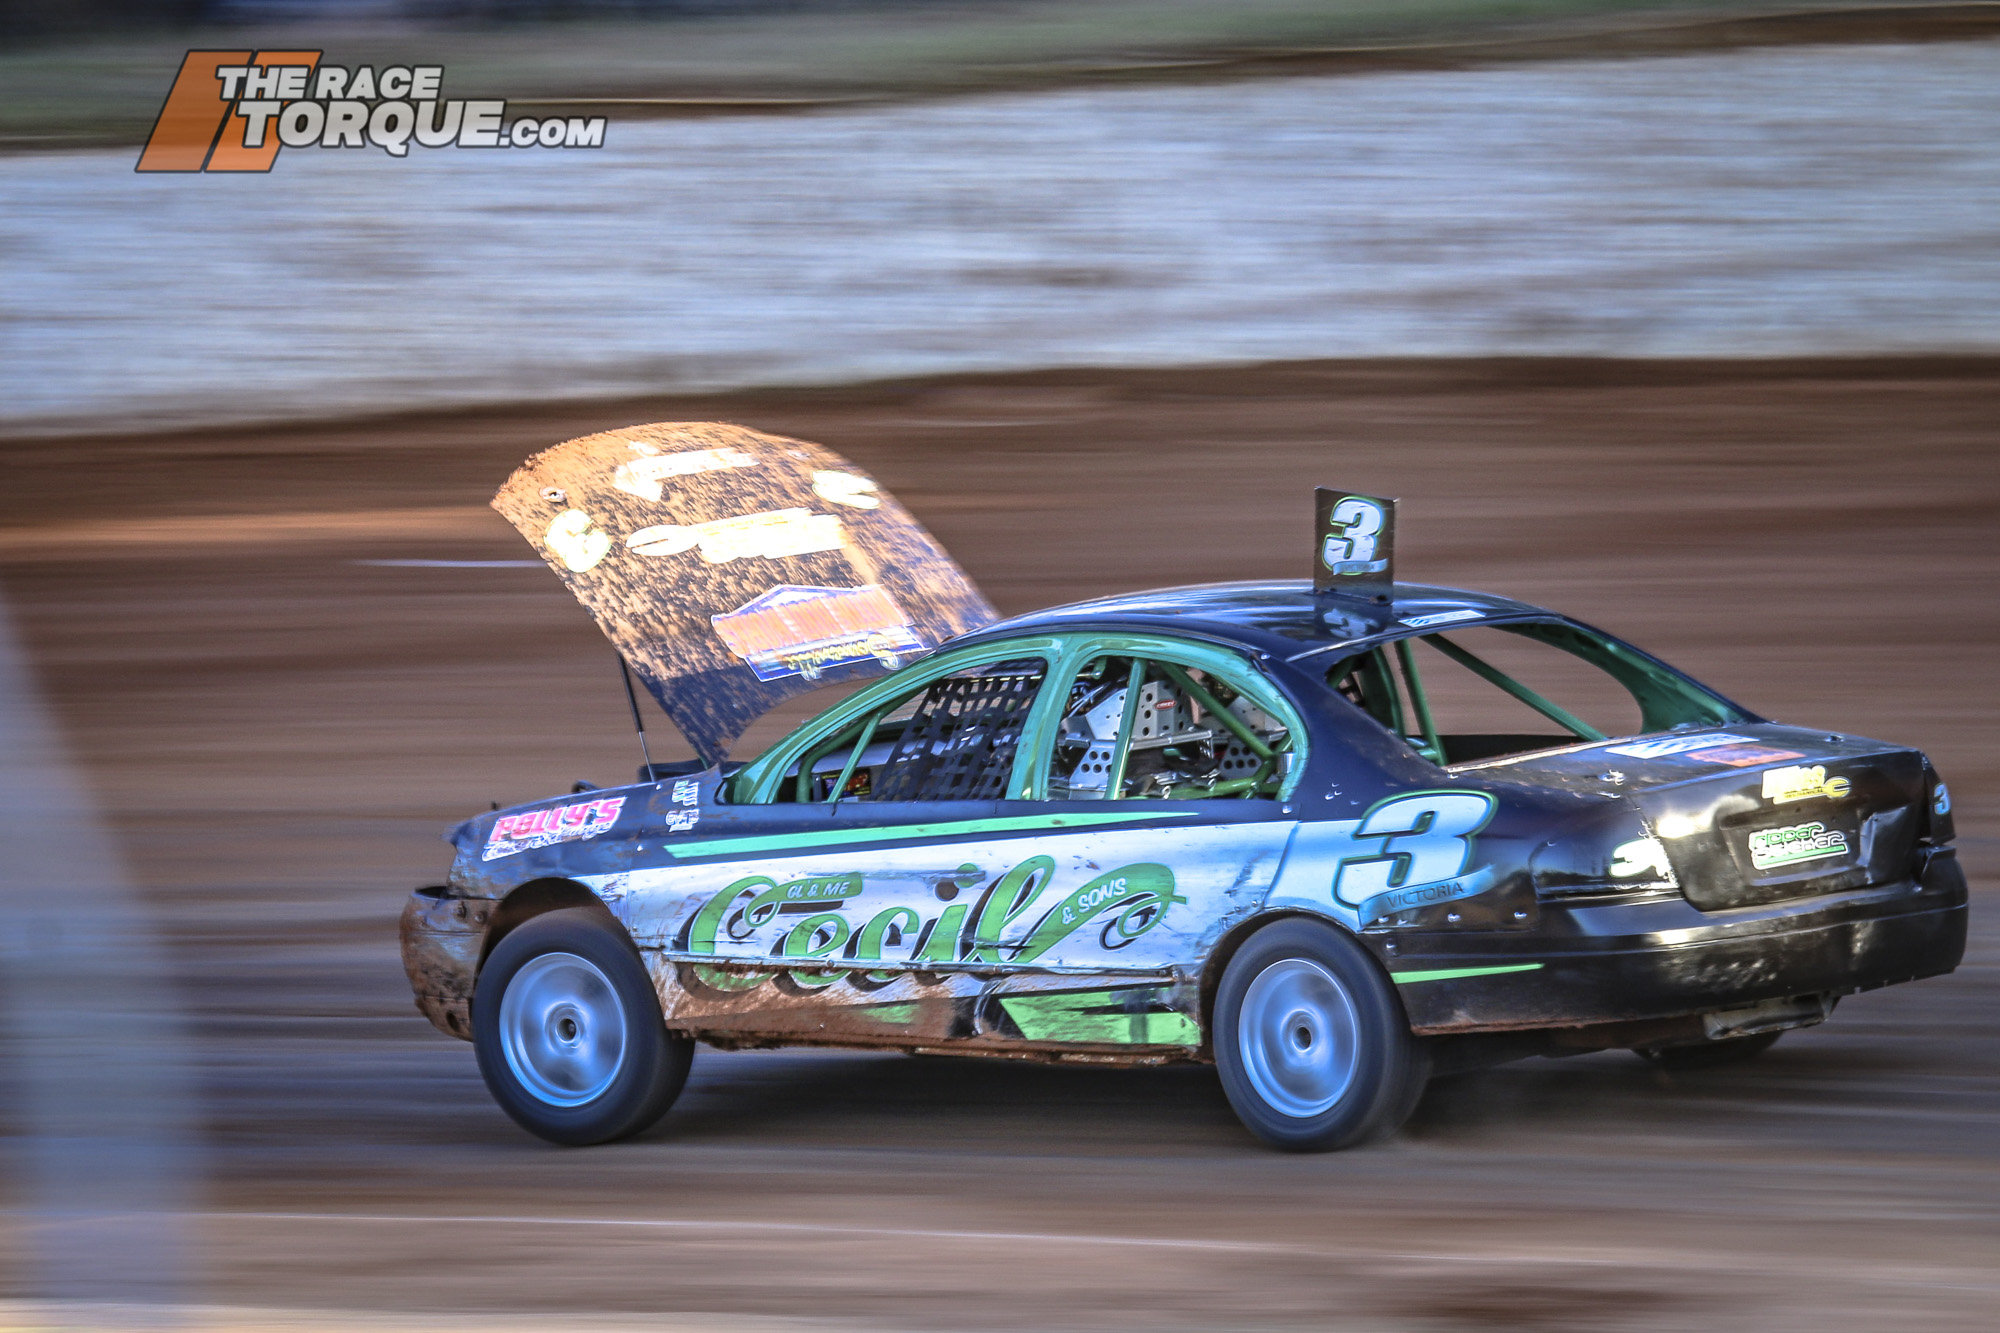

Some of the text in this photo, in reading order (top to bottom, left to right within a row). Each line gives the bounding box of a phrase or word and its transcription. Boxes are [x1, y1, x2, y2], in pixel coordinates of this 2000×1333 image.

[1322, 496, 1386, 576] 3
[1333, 789, 1498, 911] 3
[807, 883, 819, 897] &
[822, 881, 850, 896] ME
[1062, 877, 1127, 925] & SONS
[1386, 882, 1465, 908] VICTORIA
